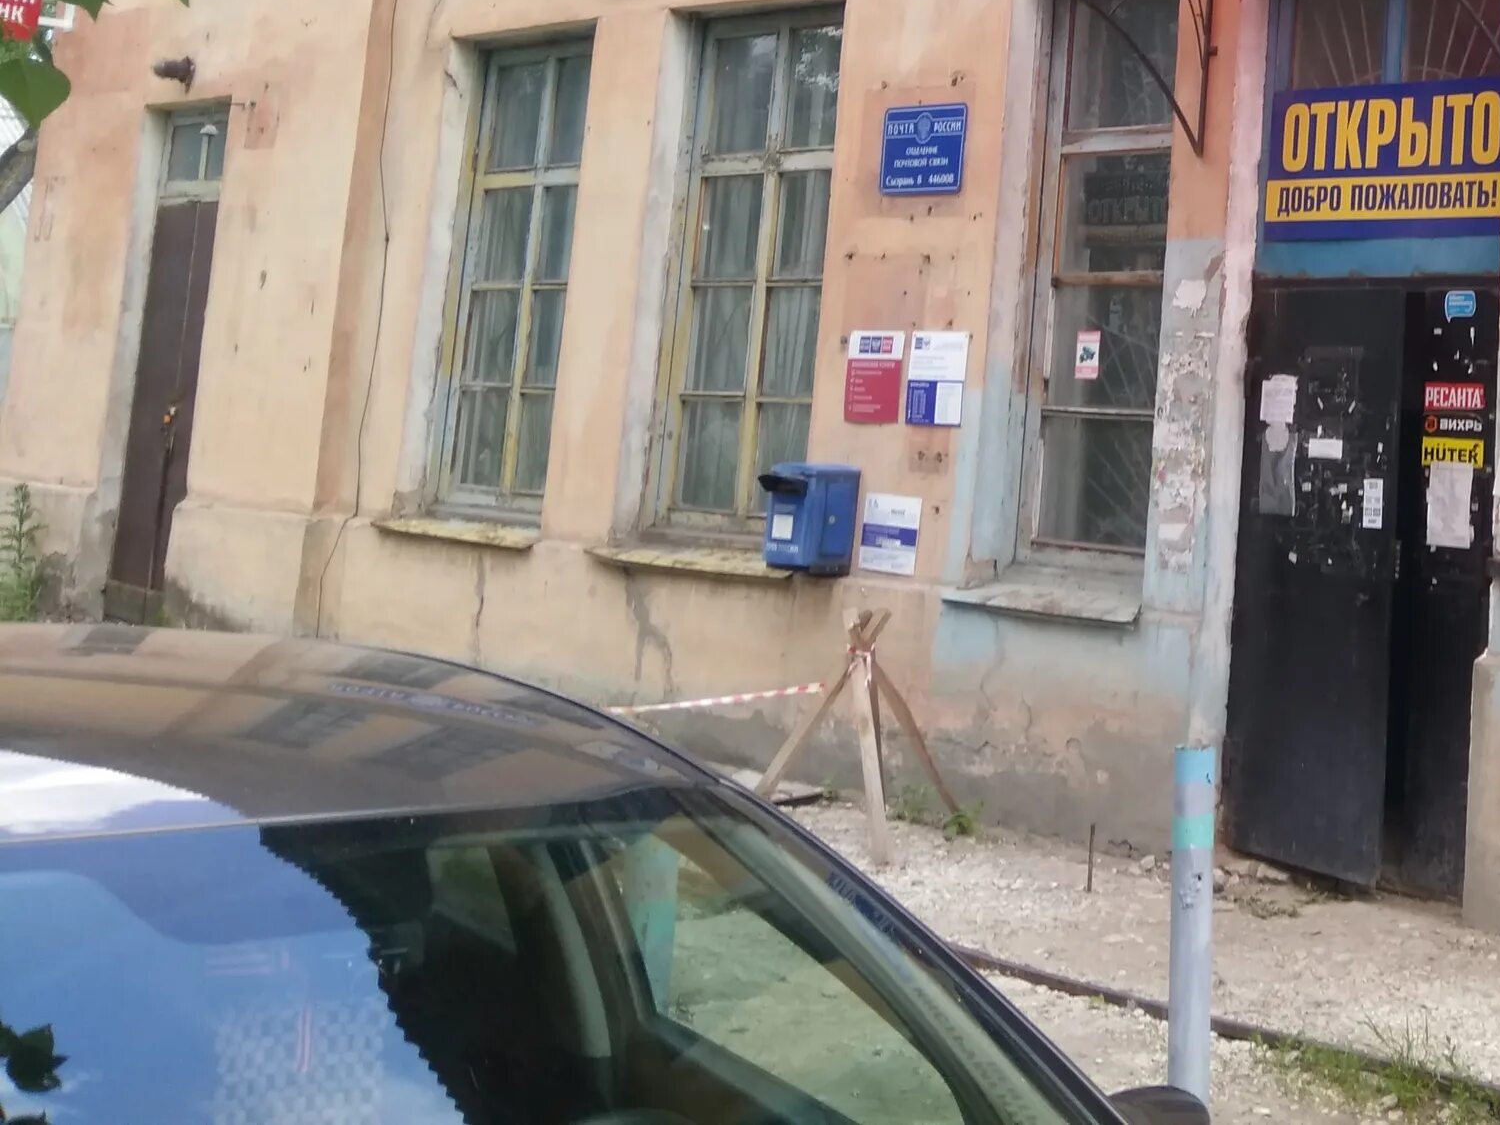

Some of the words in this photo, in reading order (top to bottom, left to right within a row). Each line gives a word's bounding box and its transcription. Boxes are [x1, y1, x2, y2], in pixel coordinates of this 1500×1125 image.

[887, 122, 914, 136] ПОЧТА
[933, 121, 962, 133] РОССИИ
[1277, 184, 1342, 218] ДОБРО
[1350, 179, 1498, 211] ПОЖАЛОВАТЬ!
[1424, 386, 1481, 409] РЕСАНТА
[1439, 417, 1483, 432] ВИХРЬ
